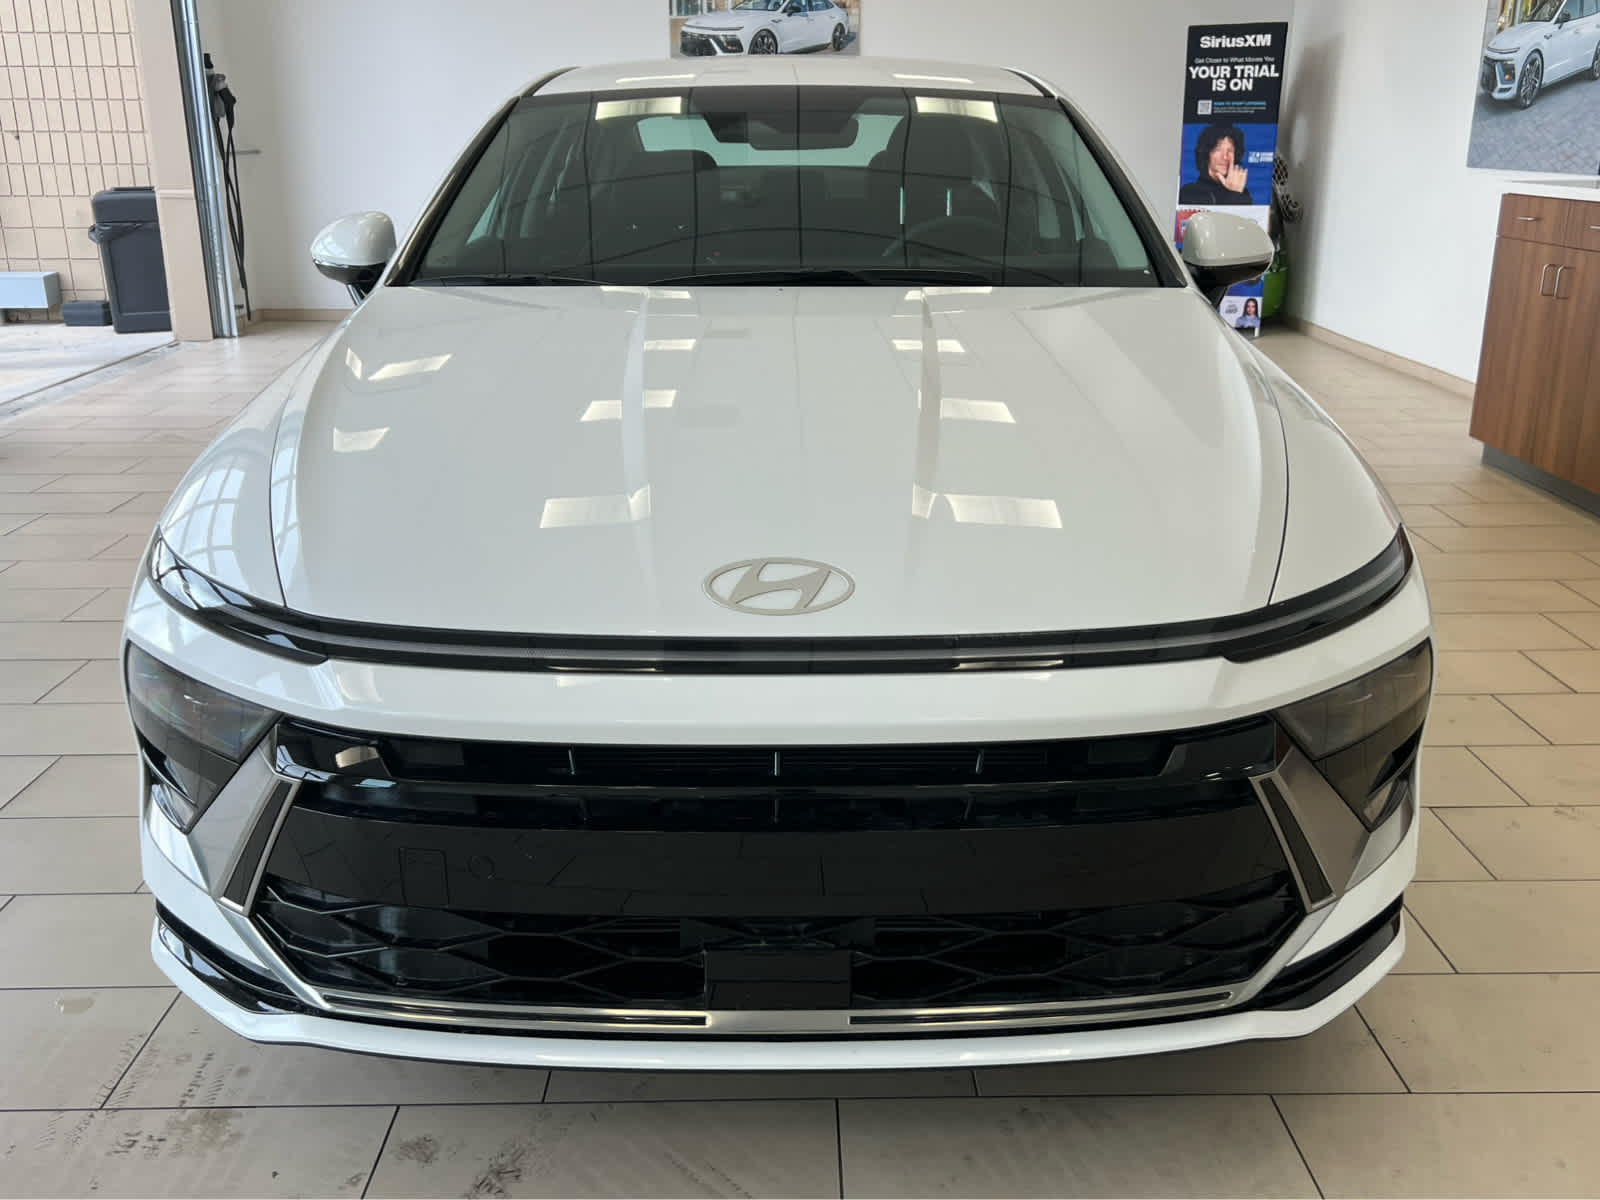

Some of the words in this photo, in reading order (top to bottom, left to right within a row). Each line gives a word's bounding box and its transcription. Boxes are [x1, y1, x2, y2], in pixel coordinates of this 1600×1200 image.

[1199, 34, 1272, 48] SiriusXM
[1189, 65, 1231, 79] YOUR
[1234, 64, 1280, 78] TRIAL
[1212, 79, 1227, 91] IS
[1229, 78, 1254, 91] ON
